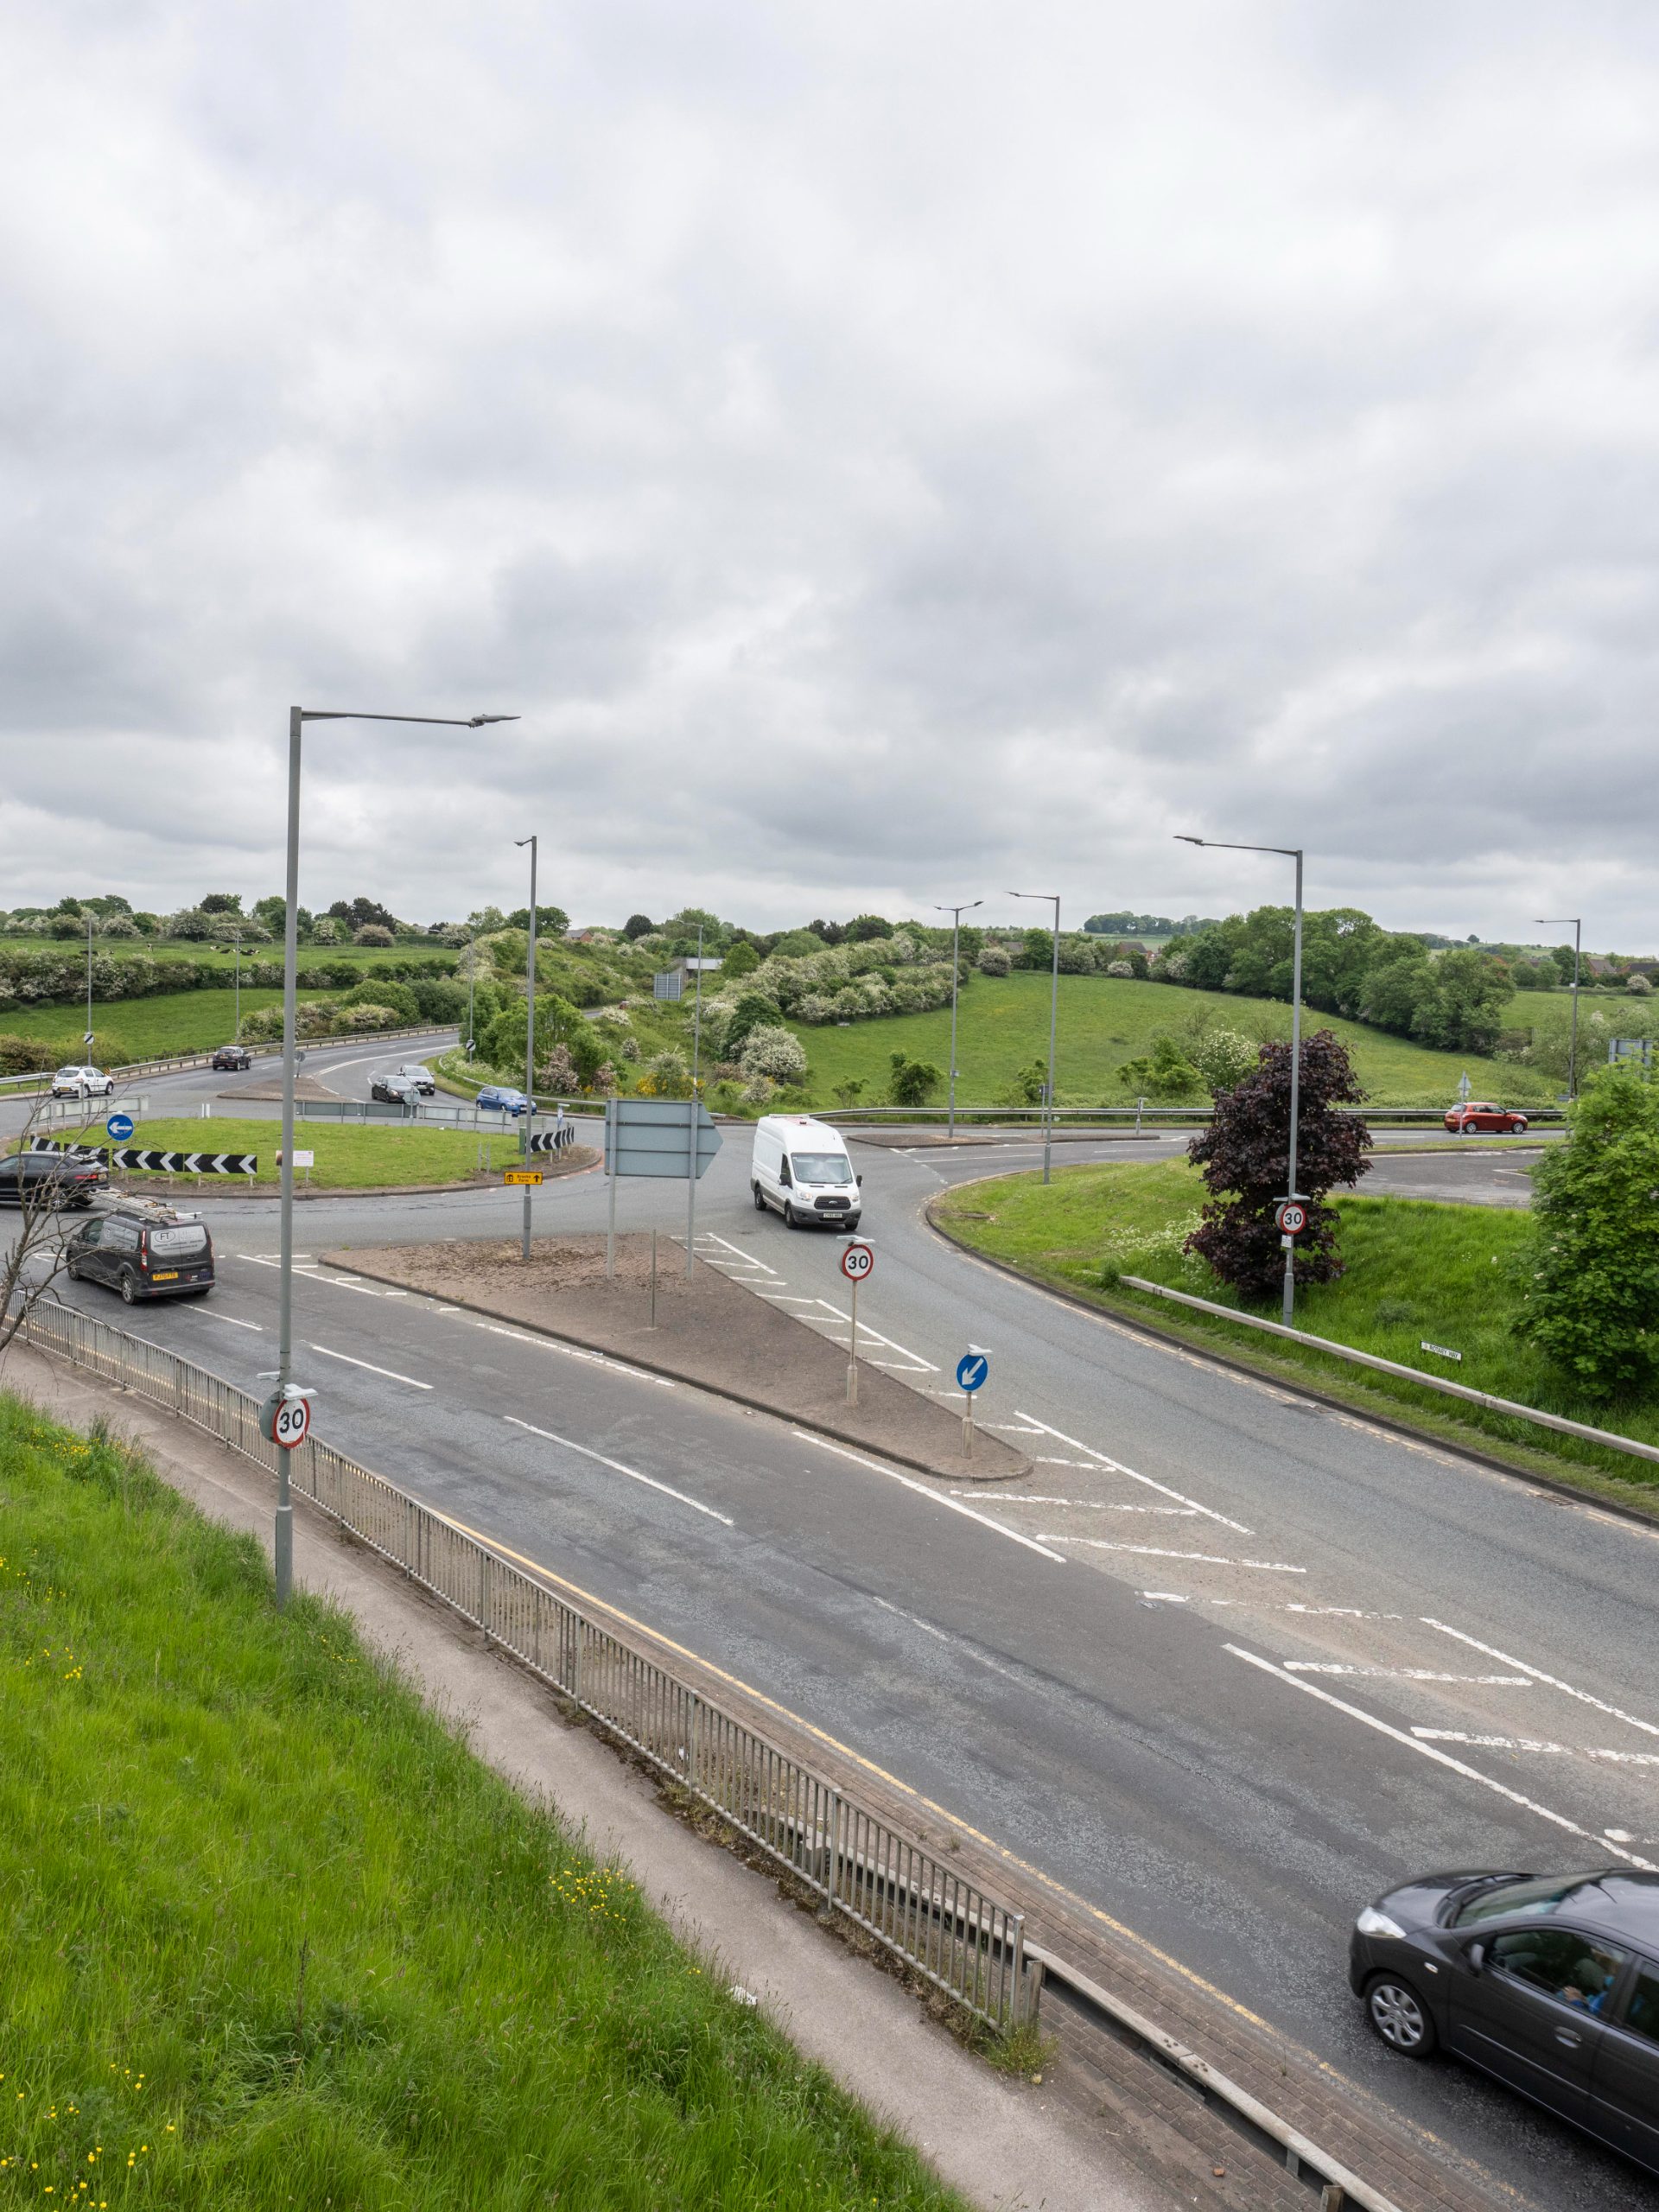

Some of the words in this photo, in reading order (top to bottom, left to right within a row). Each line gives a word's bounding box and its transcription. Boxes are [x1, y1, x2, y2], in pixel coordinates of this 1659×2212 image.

[1285, 1212, 1302, 1224] 30
[848, 1255, 868, 1269] 30
[1429, 1344, 1446, 1355] ROTARY
[279, 1408, 304, 1433] 30
